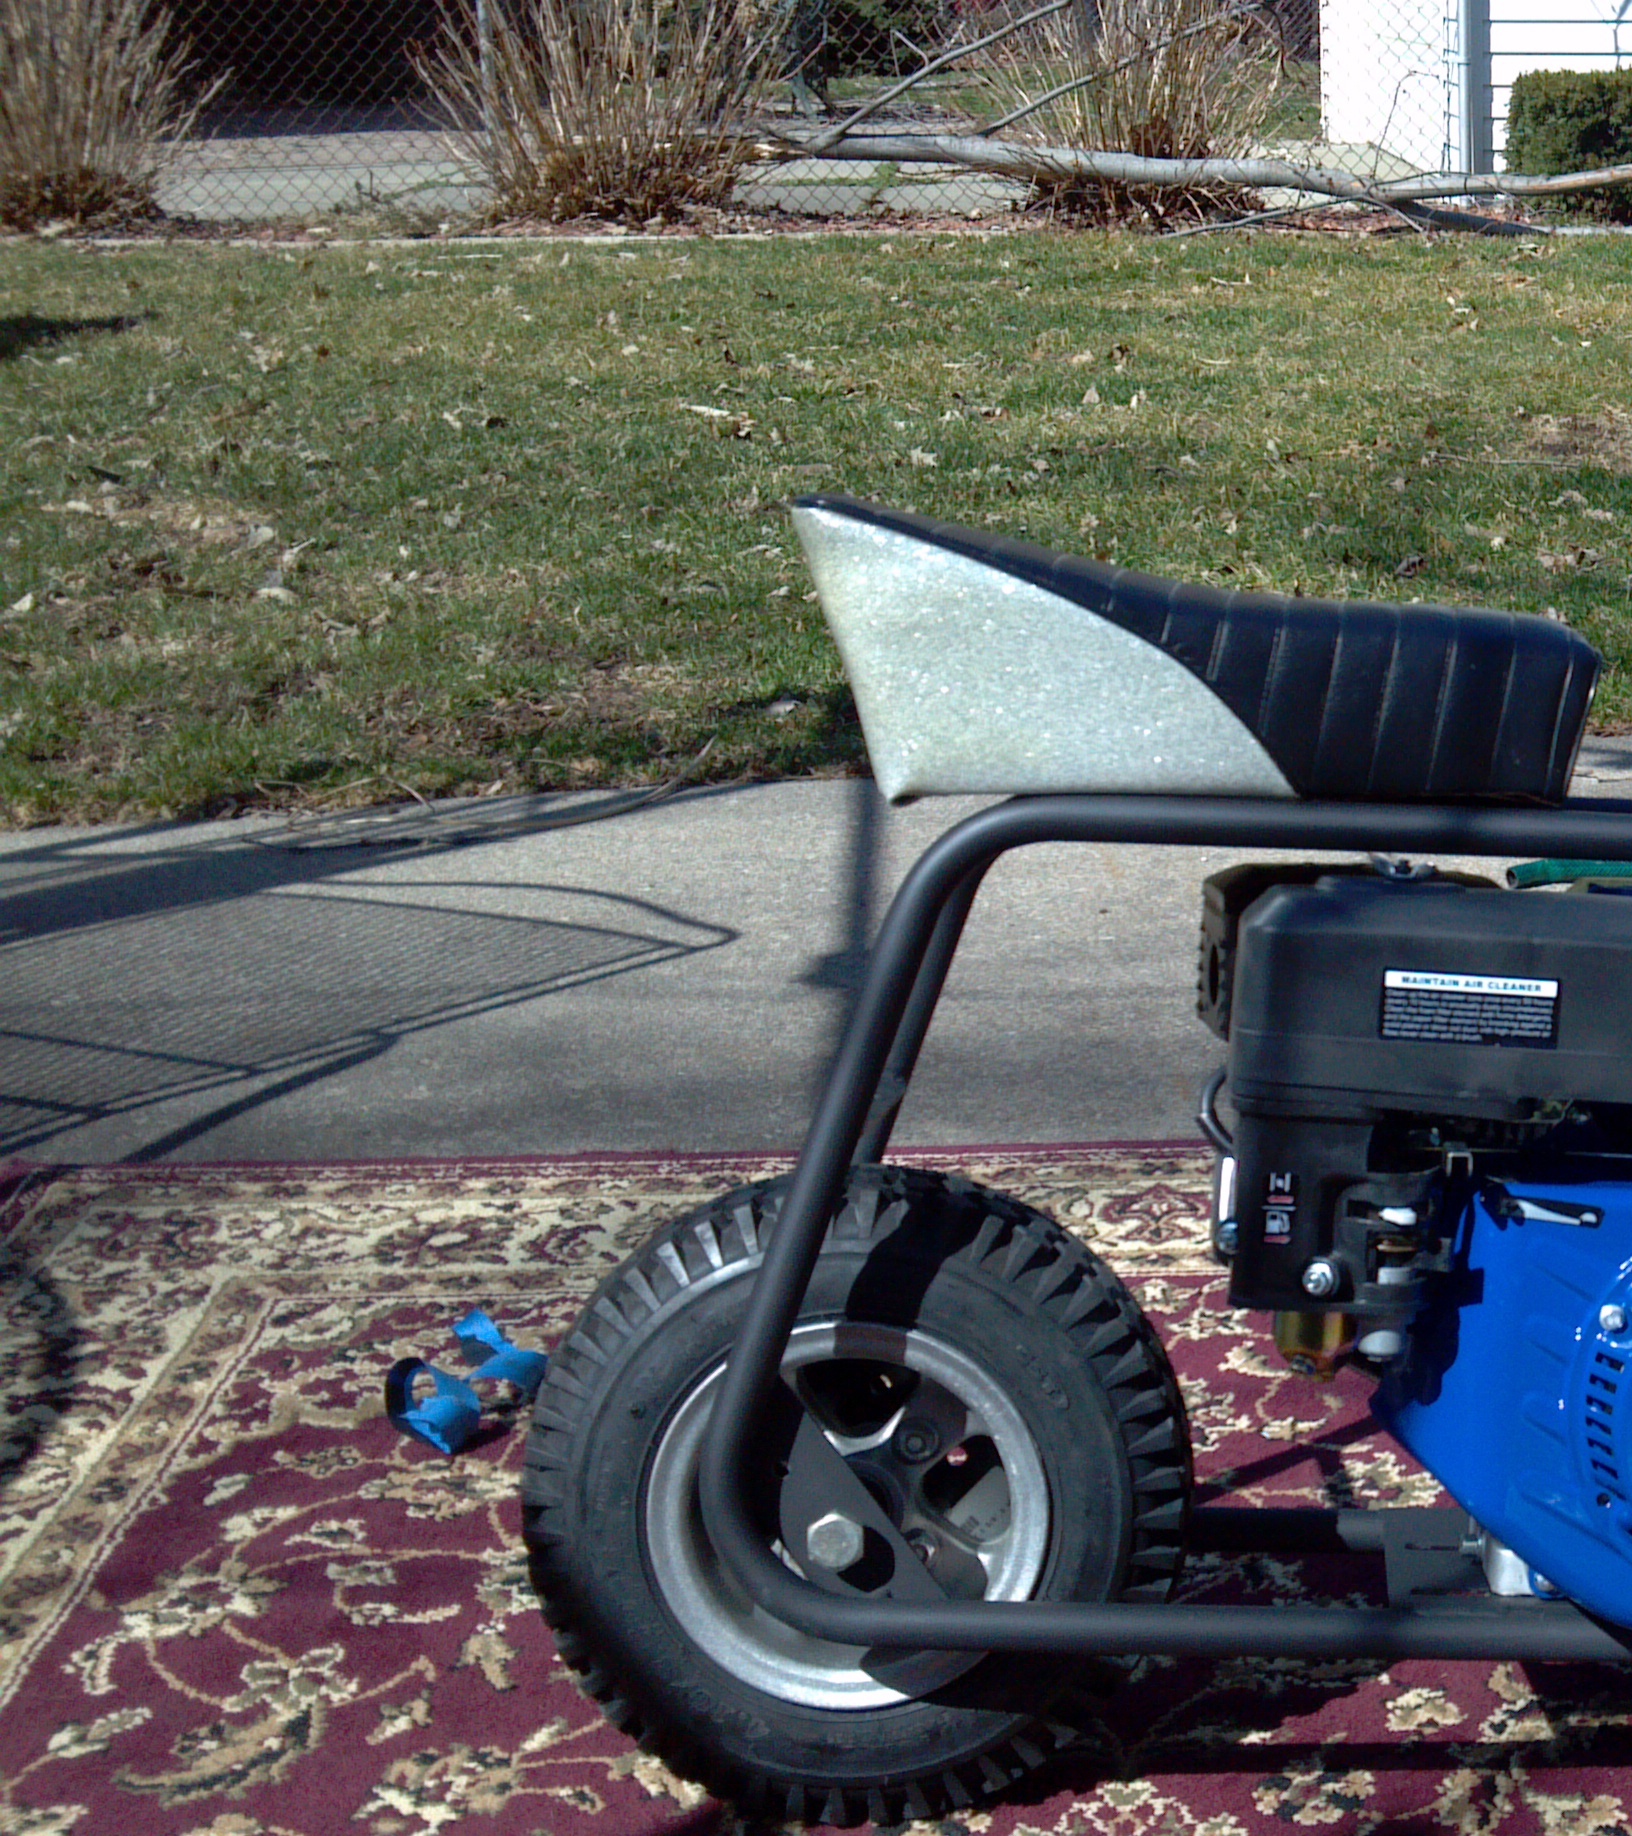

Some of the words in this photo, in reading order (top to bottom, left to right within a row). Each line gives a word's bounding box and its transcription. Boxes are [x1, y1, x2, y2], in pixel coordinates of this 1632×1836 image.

[1401, 975, 1460, 987] MAINTAIN
[1464, 979, 1484, 989] AIR
[1487, 981, 1542, 992] CLEANER
